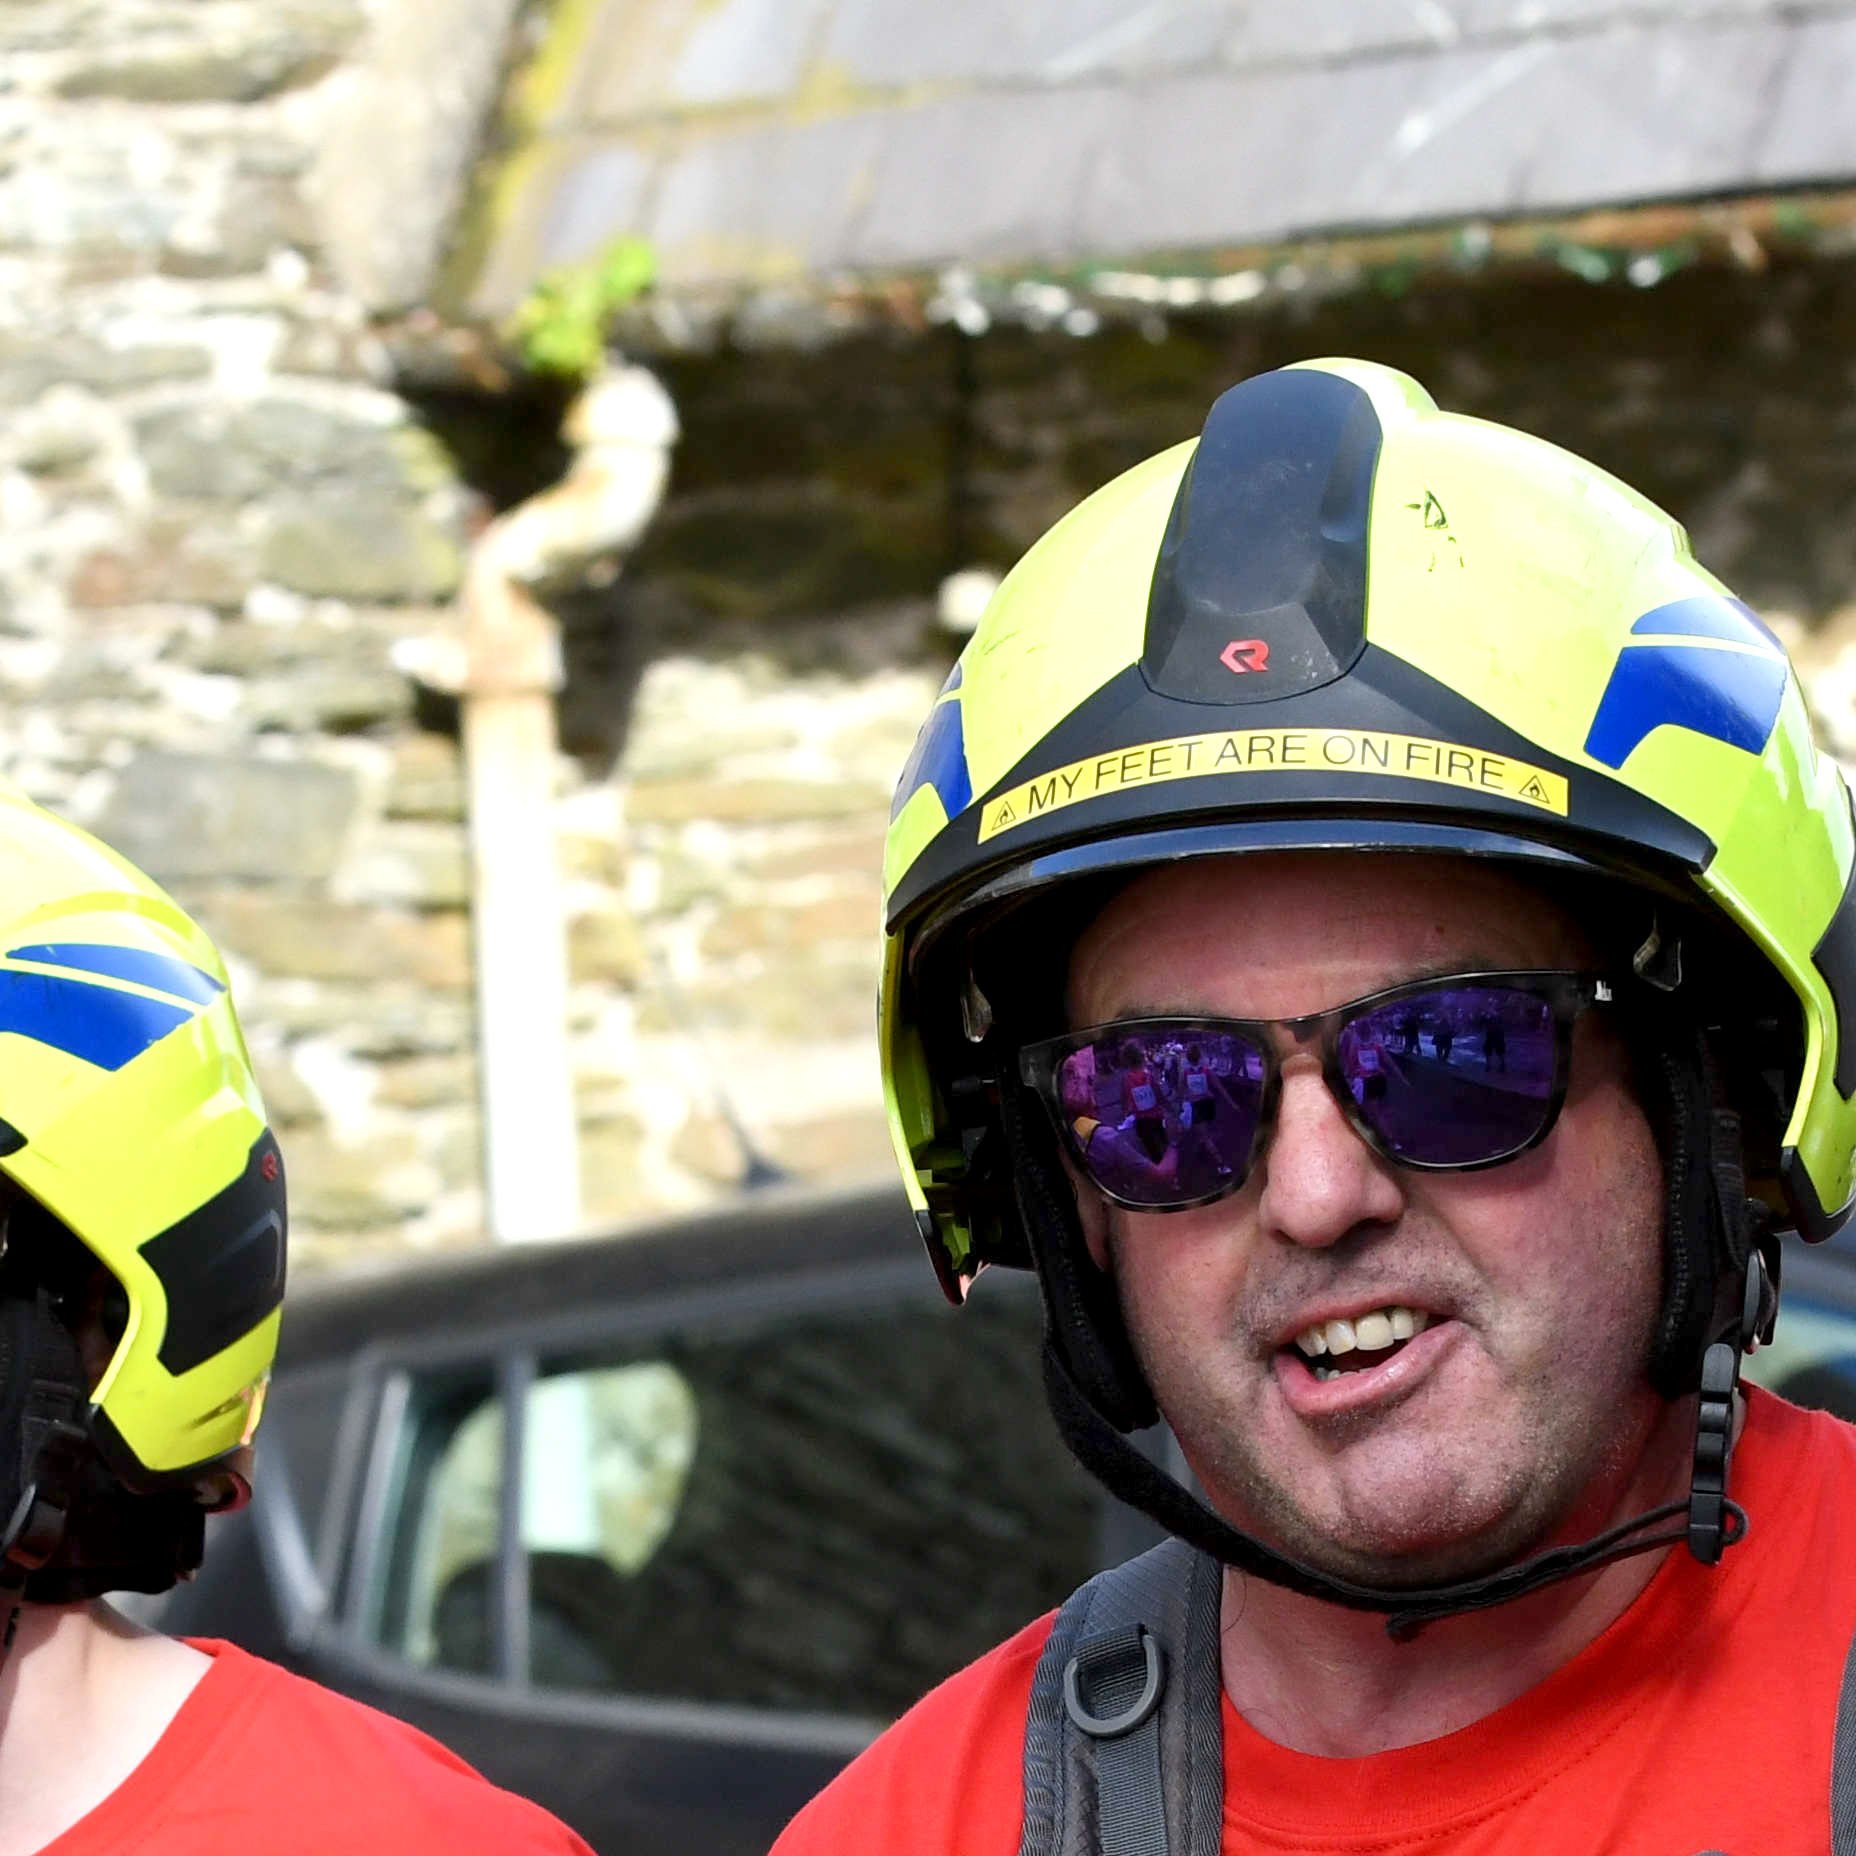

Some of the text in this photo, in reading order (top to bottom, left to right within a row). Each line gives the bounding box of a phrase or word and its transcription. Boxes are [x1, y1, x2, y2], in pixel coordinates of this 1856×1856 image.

[1027, 735, 1505, 814] MY FEET ARE ON FIRE
